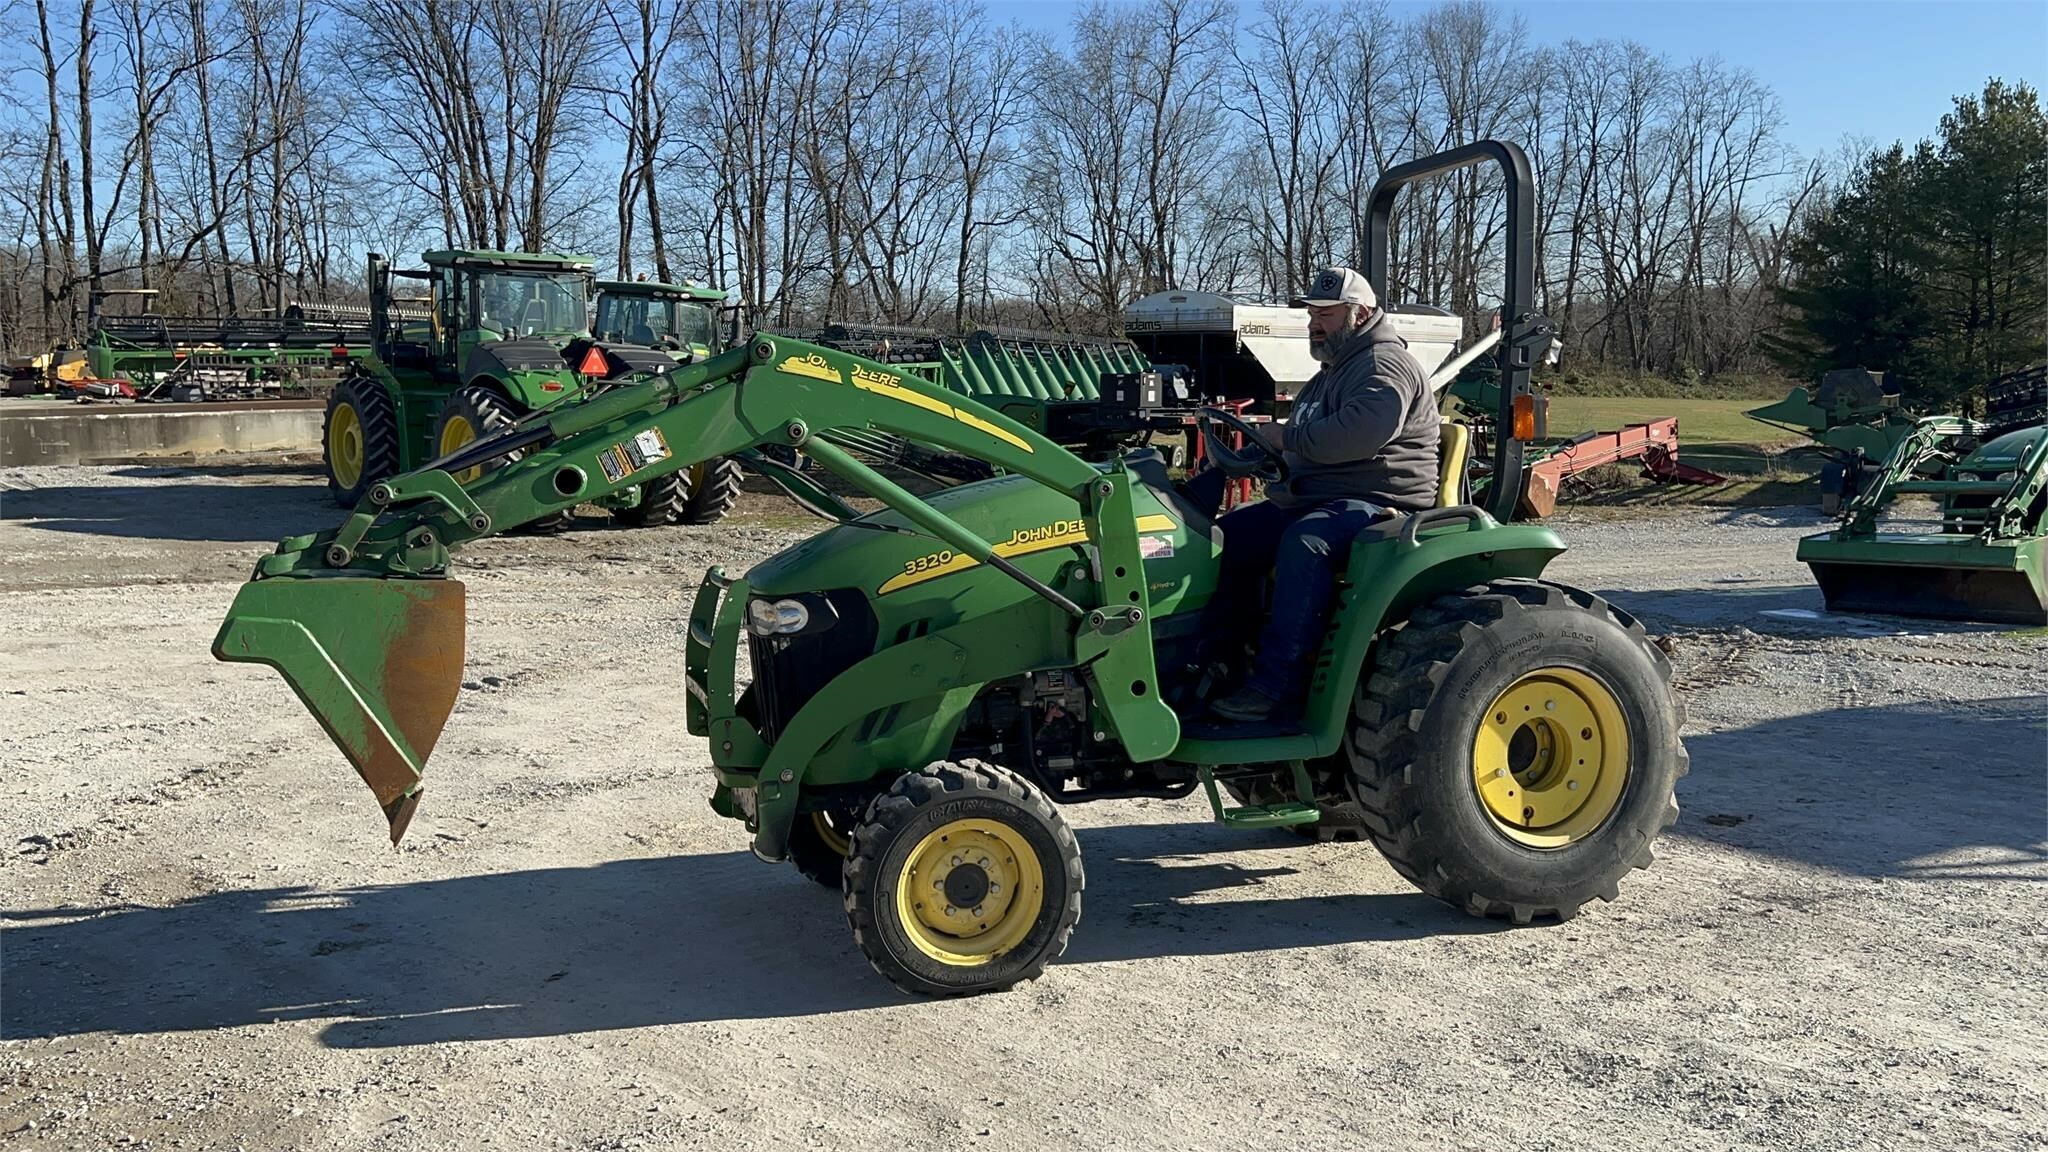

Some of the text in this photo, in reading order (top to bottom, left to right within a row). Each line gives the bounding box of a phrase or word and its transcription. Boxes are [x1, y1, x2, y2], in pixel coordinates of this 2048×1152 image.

[1125, 317, 1163, 331] adams
[1239, 321, 1270, 335] adams
[1006, 519, 1086, 546] JOHN DEE
[904, 550, 952, 575] 3320
